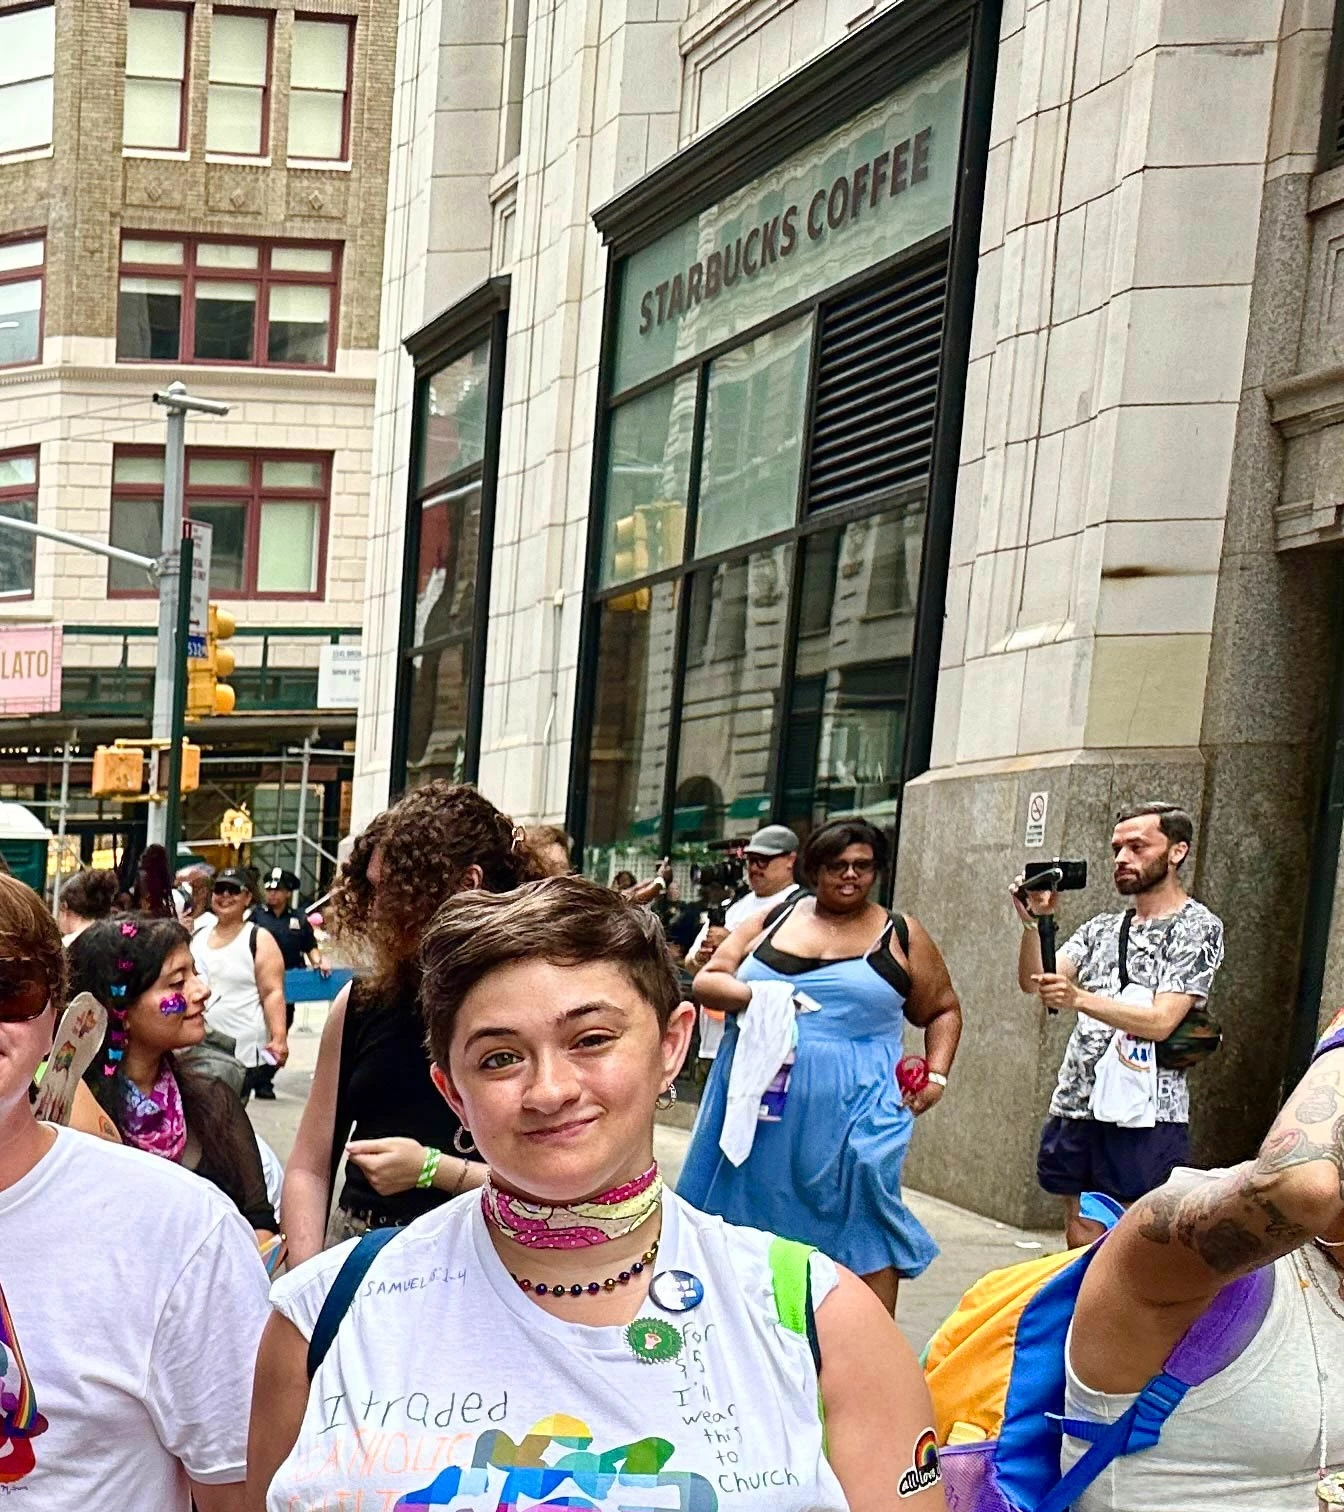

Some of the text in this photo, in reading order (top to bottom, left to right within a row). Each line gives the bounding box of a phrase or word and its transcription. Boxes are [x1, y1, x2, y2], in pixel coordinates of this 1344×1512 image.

[639, 126, 932, 336] STARBUCKS COFFEE
[316, 1390, 509, 1436] I traded
[682, 1403, 736, 1426] wear
[703, 1426, 743, 1444] this
[715, 1450, 739, 1467] to
